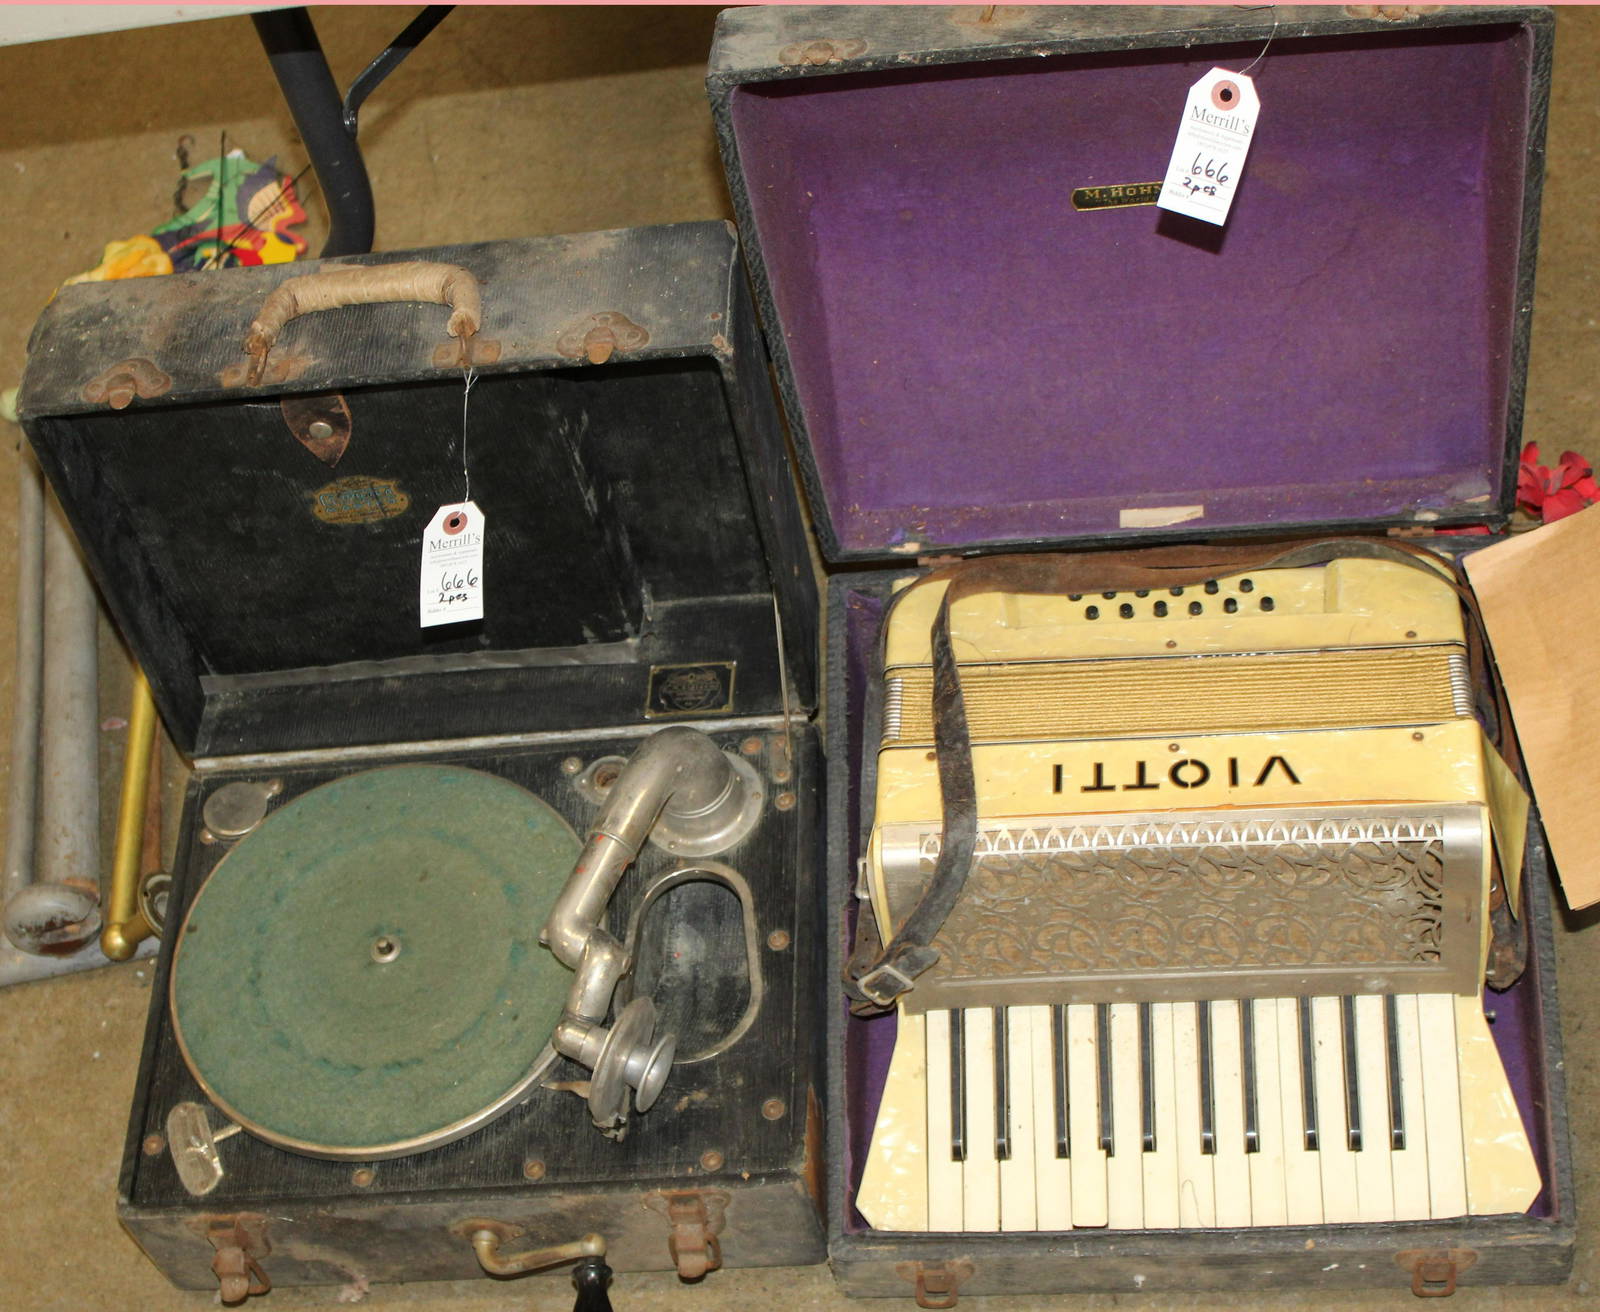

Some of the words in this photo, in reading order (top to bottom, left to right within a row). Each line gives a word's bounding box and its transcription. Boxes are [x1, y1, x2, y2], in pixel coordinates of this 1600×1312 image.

[1190, 105, 1250, 134] Merrill's
[1191, 152, 1229, 186] 666
[430, 533, 481, 550] Merrill's
[441, 568, 478, 591] 666
[1053, 755, 1302, 794] VIOTTI
